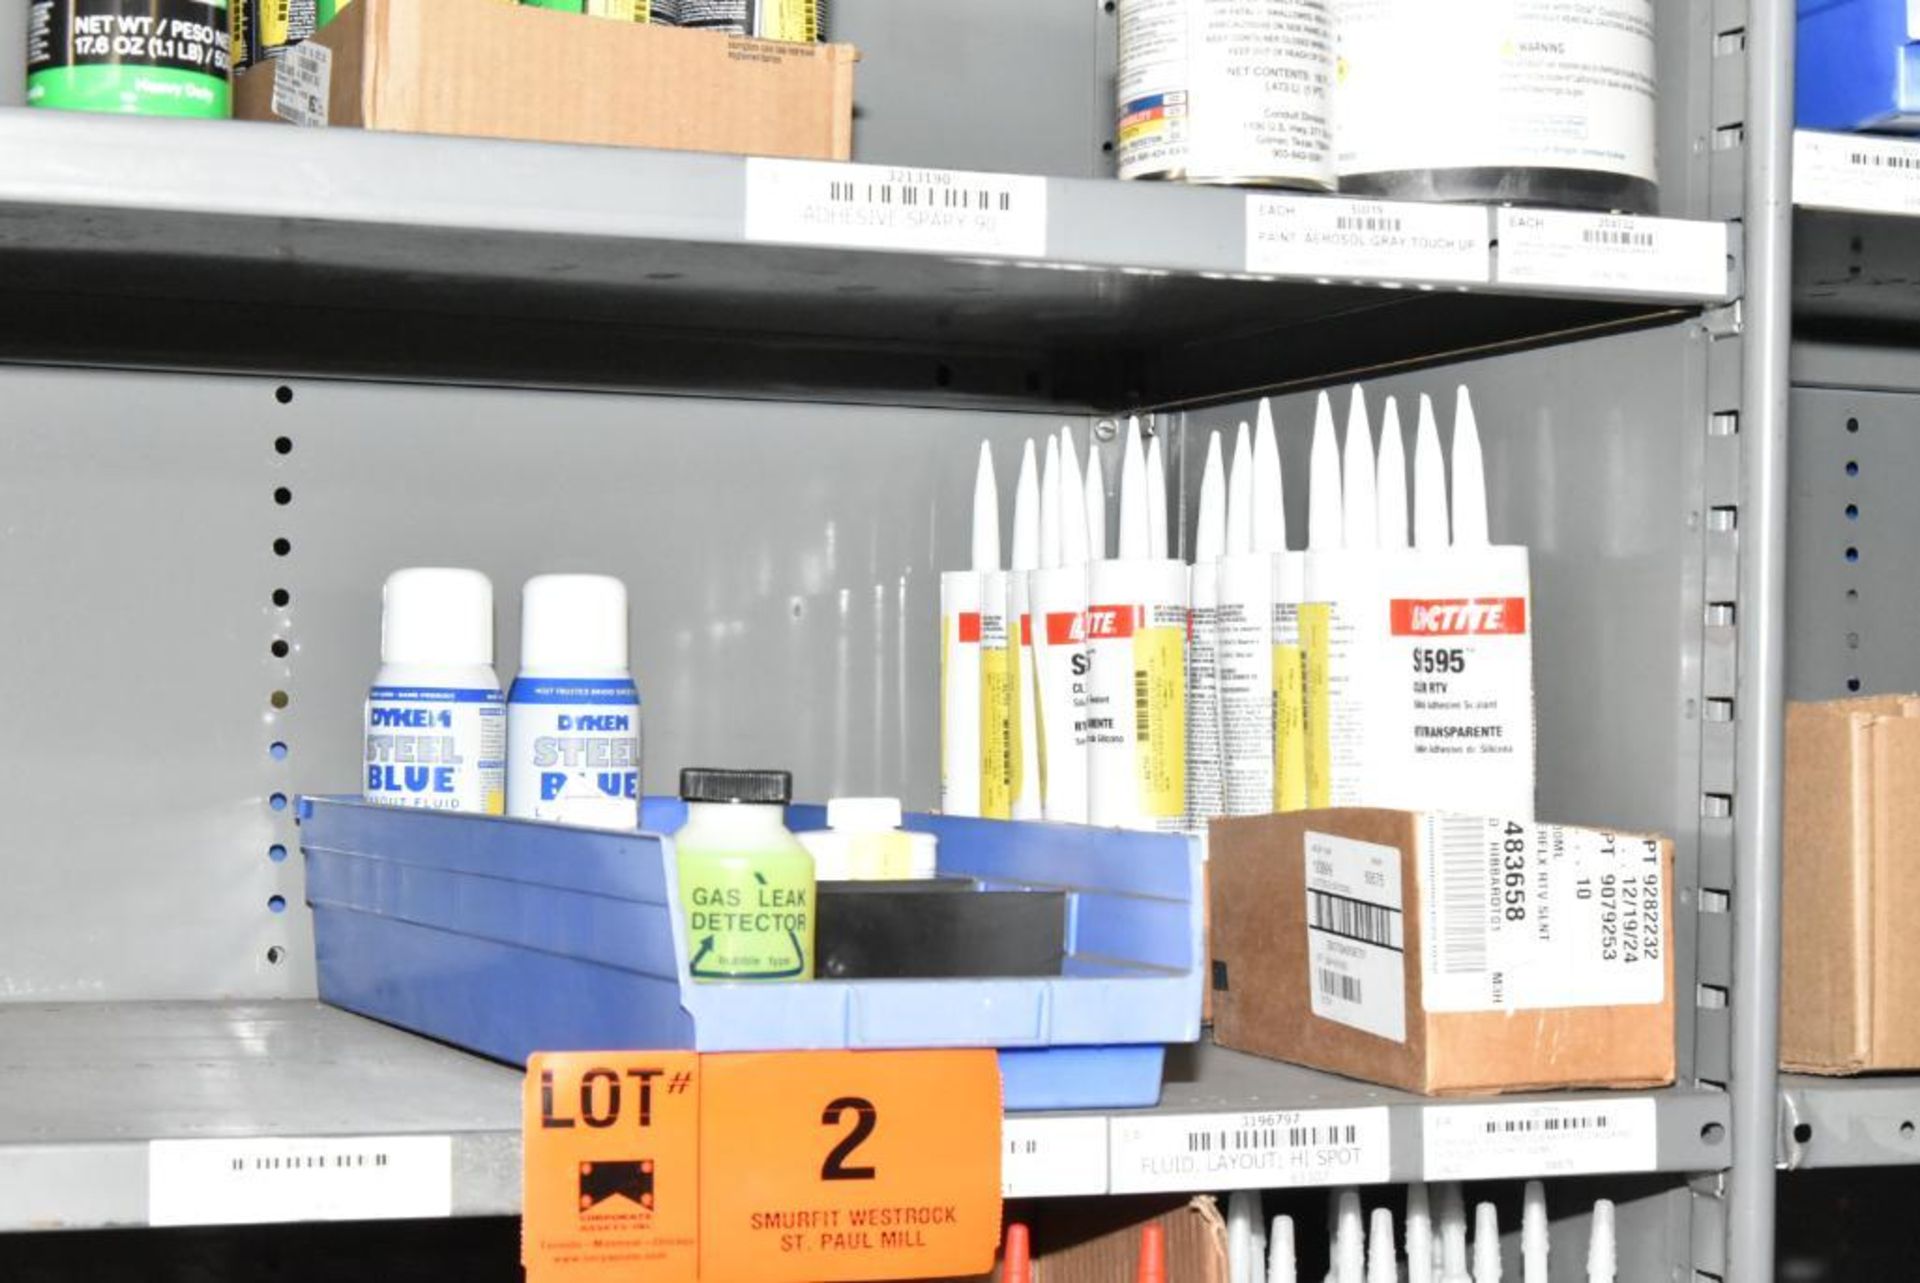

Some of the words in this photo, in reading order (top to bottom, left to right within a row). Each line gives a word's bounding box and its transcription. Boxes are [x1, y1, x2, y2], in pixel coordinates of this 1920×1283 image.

[75, 15, 113, 34] NET
[117, 15, 154, 35] WT
[171, 20, 214, 44] PESO
[75, 36, 110, 55] 17.6
[113, 36, 145, 55] OZ
[148, 37, 174, 59] (1.1
[177, 41, 204, 64] LB)
[1227, 66, 1249, 77] NET
[135, 79, 181, 96] Heavy
[1259, 204, 1295, 216] EACH
[1508, 215, 1544, 229] EACH
[1411, 235, 1454, 249] TOUCH
[557, 714, 630, 731] DYKEM
[368, 764, 455, 794] BLUE
[541, 771, 638, 801] BUE
[1503, 820, 1527, 923] 483658
[691, 886, 741, 907] GAS
[757, 887, 806, 908] LEAK
[1576, 877, 1592, 900] 10
[691, 911, 807, 933] DETECTOR
[1600, 873, 1617, 961] 9079253
[1622, 876, 1639, 963] 12/19/24
[1642, 874, 1659, 960] 9282232
[541, 1067, 665, 1128] LOT
[820, 1096, 877, 1181] 2
[1289, 1148, 1310, 1168] HI
[1317, 1146, 1362, 1166] SPOT
[751, 1210, 840, 1231] SMURFIT
[849, 1205, 957, 1227] WESTROCK
[780, 1234, 813, 1252] ST.
[820, 1231, 874, 1250] PAUL
[880, 1229, 927, 1248] MILL
